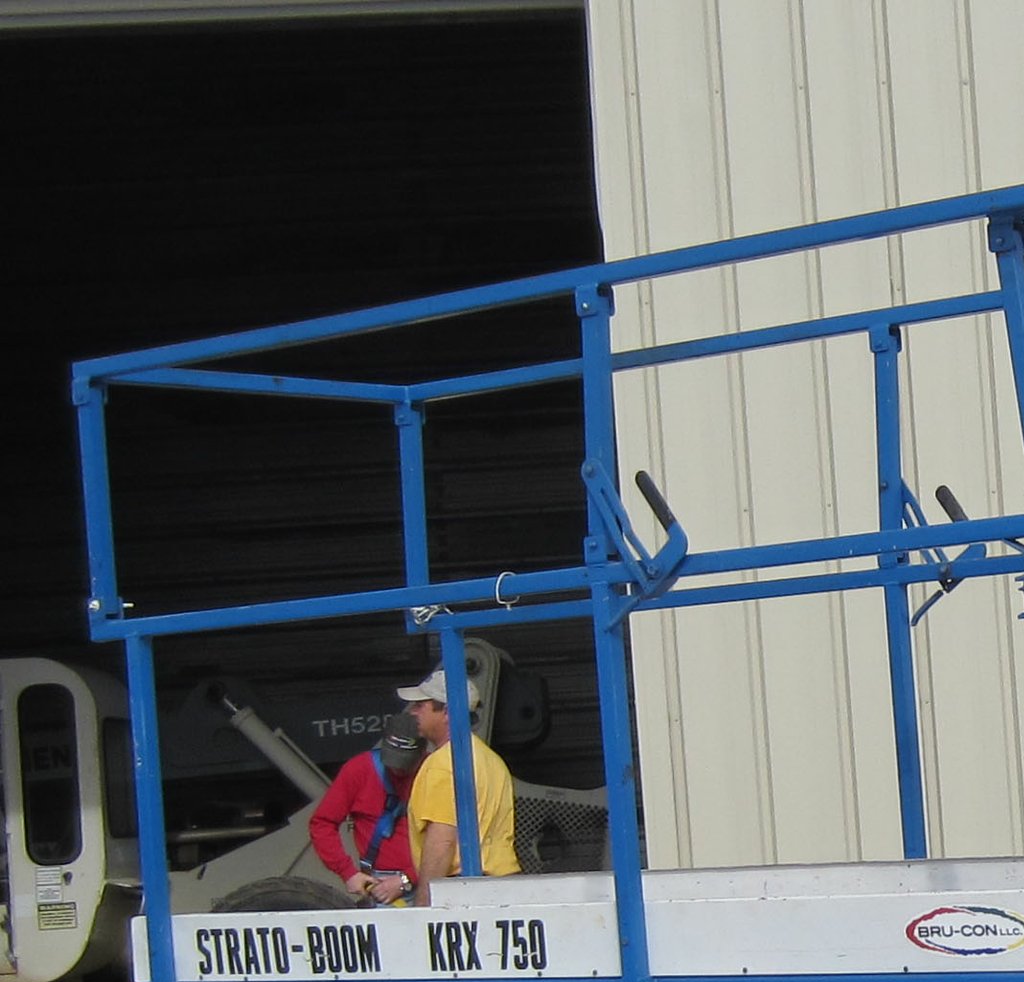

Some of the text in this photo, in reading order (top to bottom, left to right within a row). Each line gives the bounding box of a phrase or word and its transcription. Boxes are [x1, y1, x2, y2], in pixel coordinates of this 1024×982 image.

[196, 918, 547, 977] STRATO-BOOM KRX 750
[917, 924, 998, 939] BRU-CON
